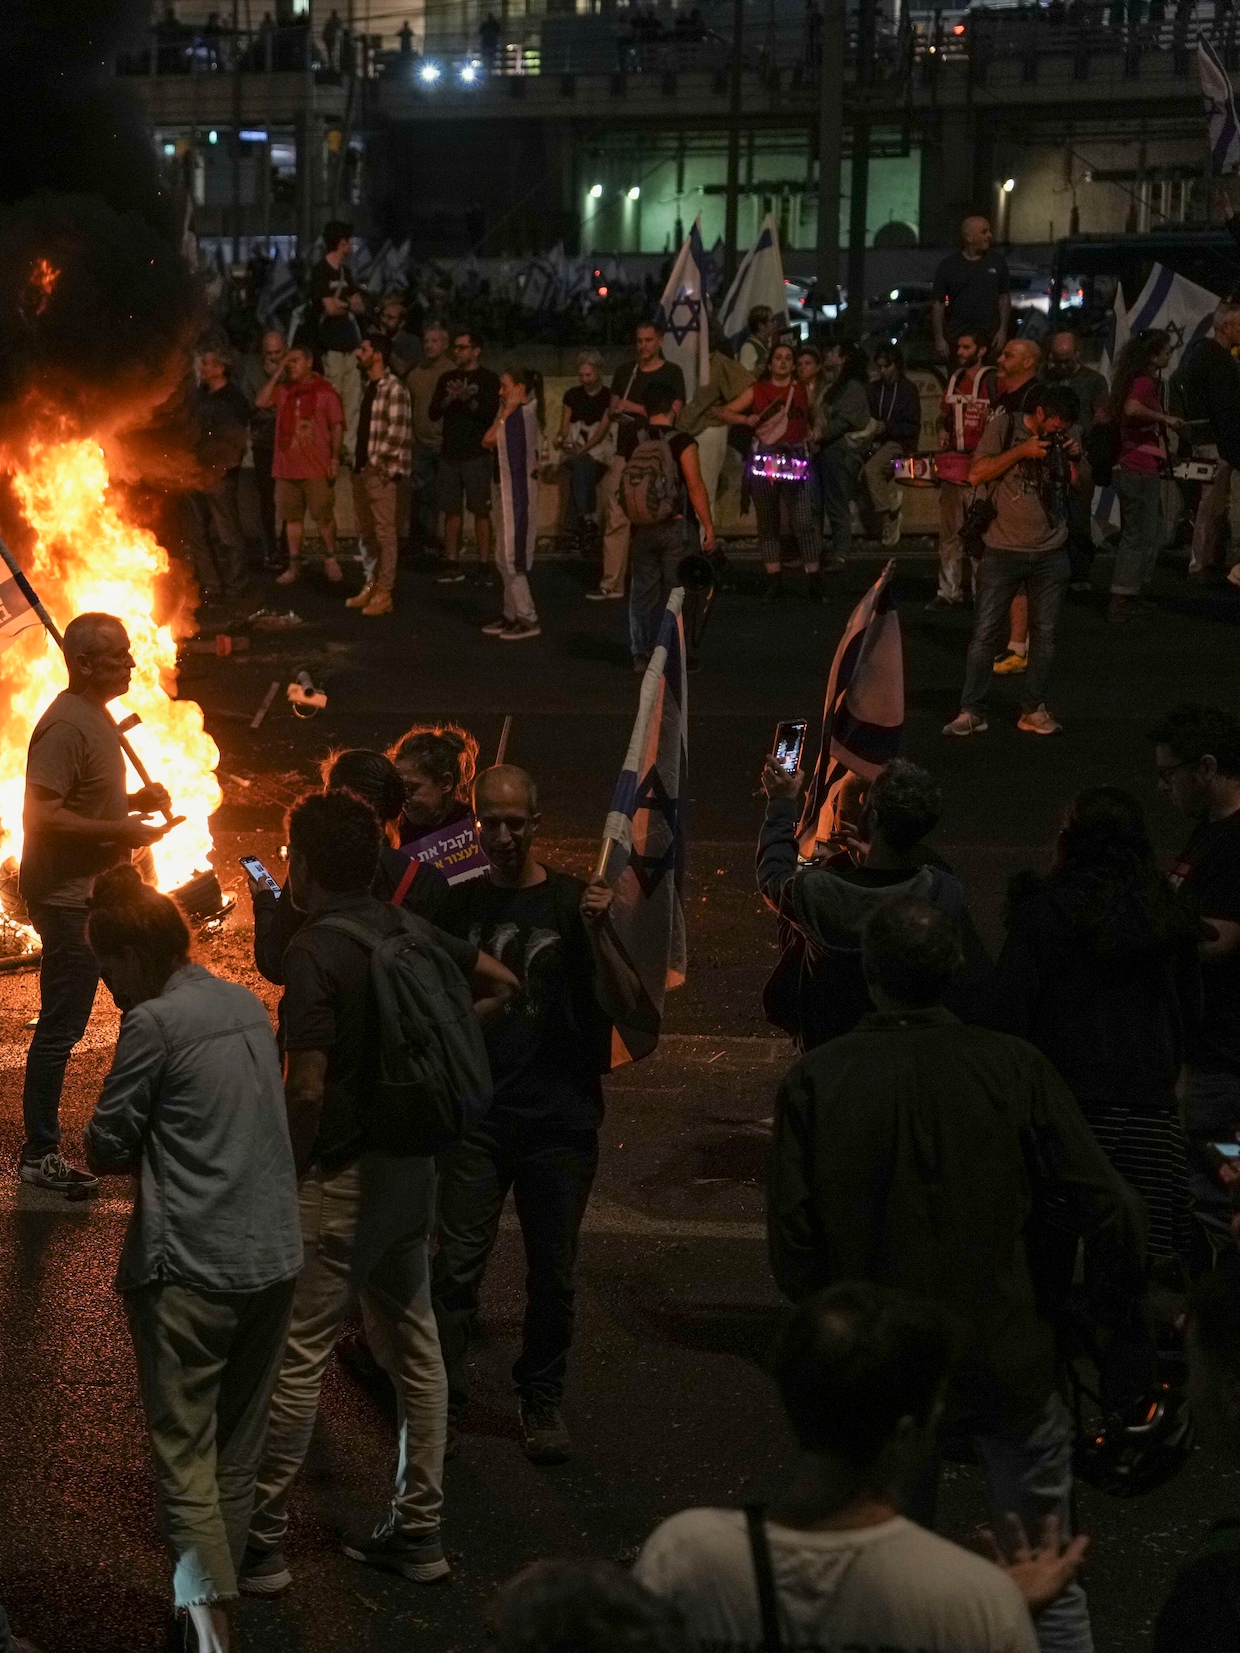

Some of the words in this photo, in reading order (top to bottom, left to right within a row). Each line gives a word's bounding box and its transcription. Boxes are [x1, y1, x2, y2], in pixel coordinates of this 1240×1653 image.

[438, 829, 474, 853] לקבל
[417, 846, 440, 863] את
[444, 844, 479, 865] לעצור
